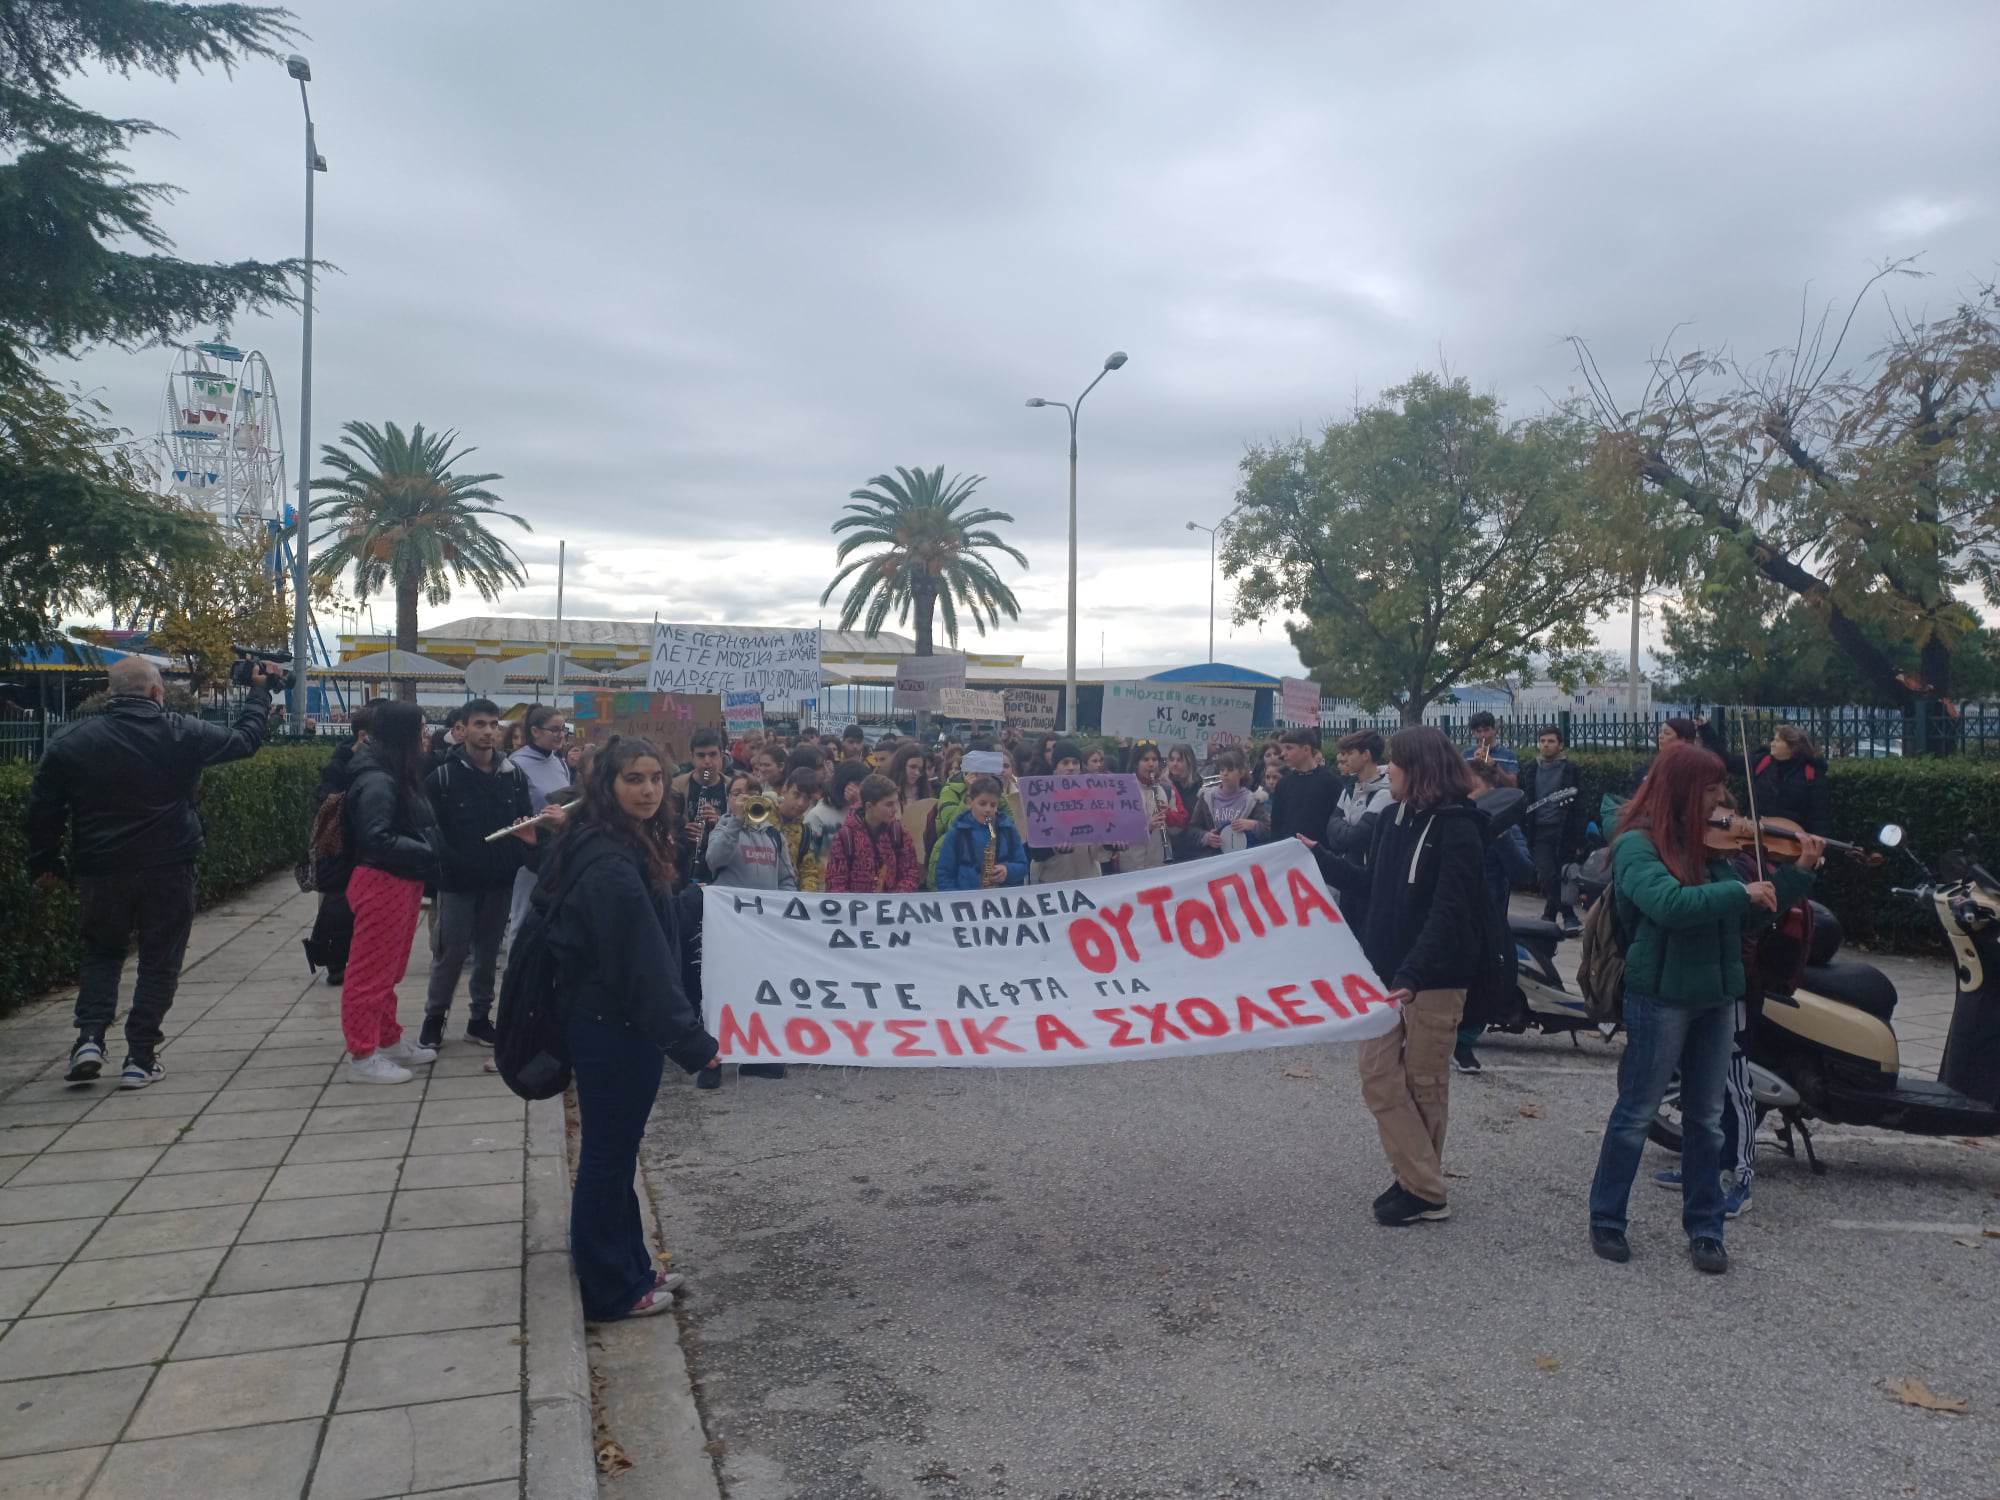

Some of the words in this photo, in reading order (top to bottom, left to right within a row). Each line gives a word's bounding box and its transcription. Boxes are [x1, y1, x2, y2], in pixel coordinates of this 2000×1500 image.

[657, 625, 688, 642] ΜΕ
[656, 643, 711, 666] ΛΕΤΕ
[715, 650, 773, 669] ΜΟΥΣΙΚΑ
[1148, 719, 1188, 740] ΕΙΝΑΙ
[1156, 706, 1173, 721] ΚΙ
[1181, 709, 1217, 727] ΟΜΩΣ
[733, 895, 764, 915] Η
[783, 896, 944, 926] ΔΩΡΕΑΝ
[950, 889, 1097, 923] ΠΑΙΔΕΙΑ
[828, 928, 912, 949] ΔΕΝ
[952, 921, 1051, 949] ΕΙΝΑΙ
[1067, 863, 1343, 975] ΟΥΤΟΠΙΑ
[754, 977, 922, 1011] ΔΩΣΤΕ
[956, 975, 1069, 1009] ΛΕΦΤΑ
[1093, 977, 1151, 998] ΓΙΑ
[717, 1003, 1089, 1058] ΜΟΥΣΙΚΑ
[1092, 972, 1402, 1048] ΣΧΟΛΕΙΑ
